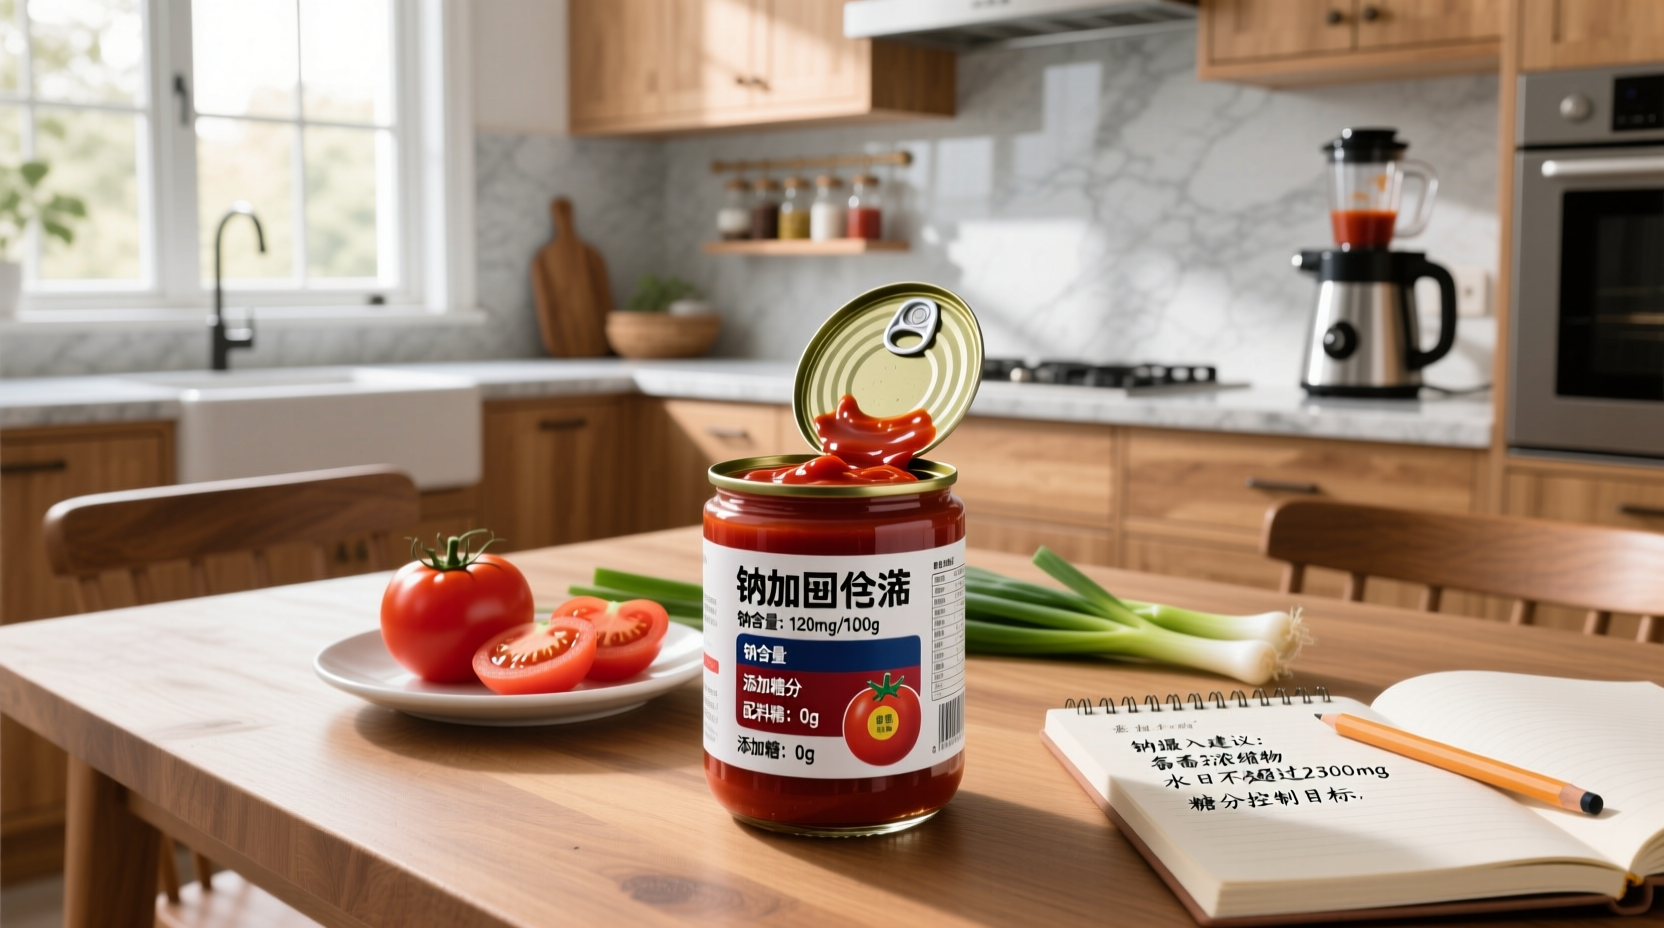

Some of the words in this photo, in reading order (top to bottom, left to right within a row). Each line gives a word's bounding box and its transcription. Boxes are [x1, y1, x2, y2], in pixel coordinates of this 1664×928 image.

[789, 616, 880, 635] 120mg/100g
[799, 707, 820, 729] 0g
[794, 744, 815, 766] 0g
